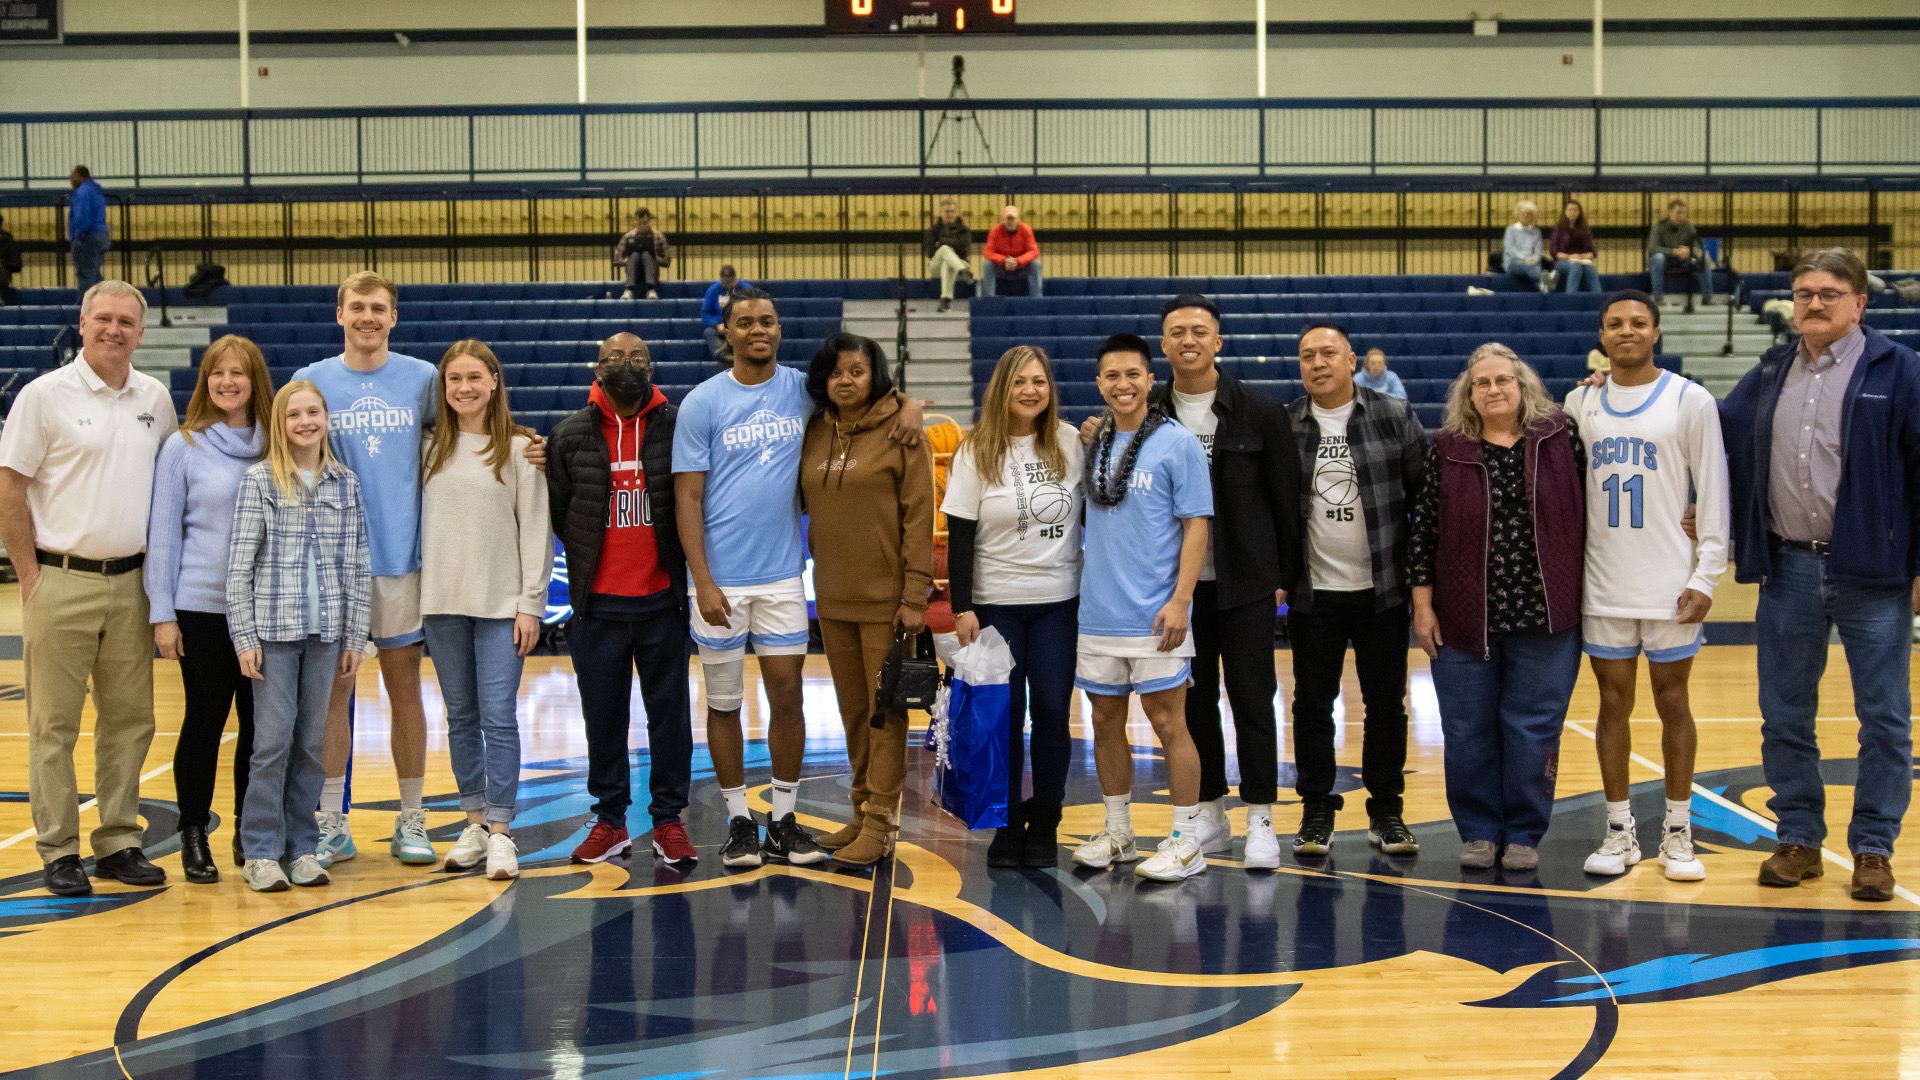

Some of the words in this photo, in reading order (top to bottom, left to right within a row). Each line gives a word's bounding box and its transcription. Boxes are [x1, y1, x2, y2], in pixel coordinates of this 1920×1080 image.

[902, 12, 938, 29] period
[956, 8, 964, 30] 1
[328, 409, 413, 430] GORDON
[331, 426, 411, 437] BASKETBALL
[722, 417, 804, 446] GORDON
[1320, 436, 1348, 445] SENI
[1318, 446, 1349, 459] 202
[1592, 436, 1658, 471] SCOTS
[1602, 473, 1644, 529] 11
[1326, 507, 1354, 521] #15
[1040, 525, 1064, 539] #15
